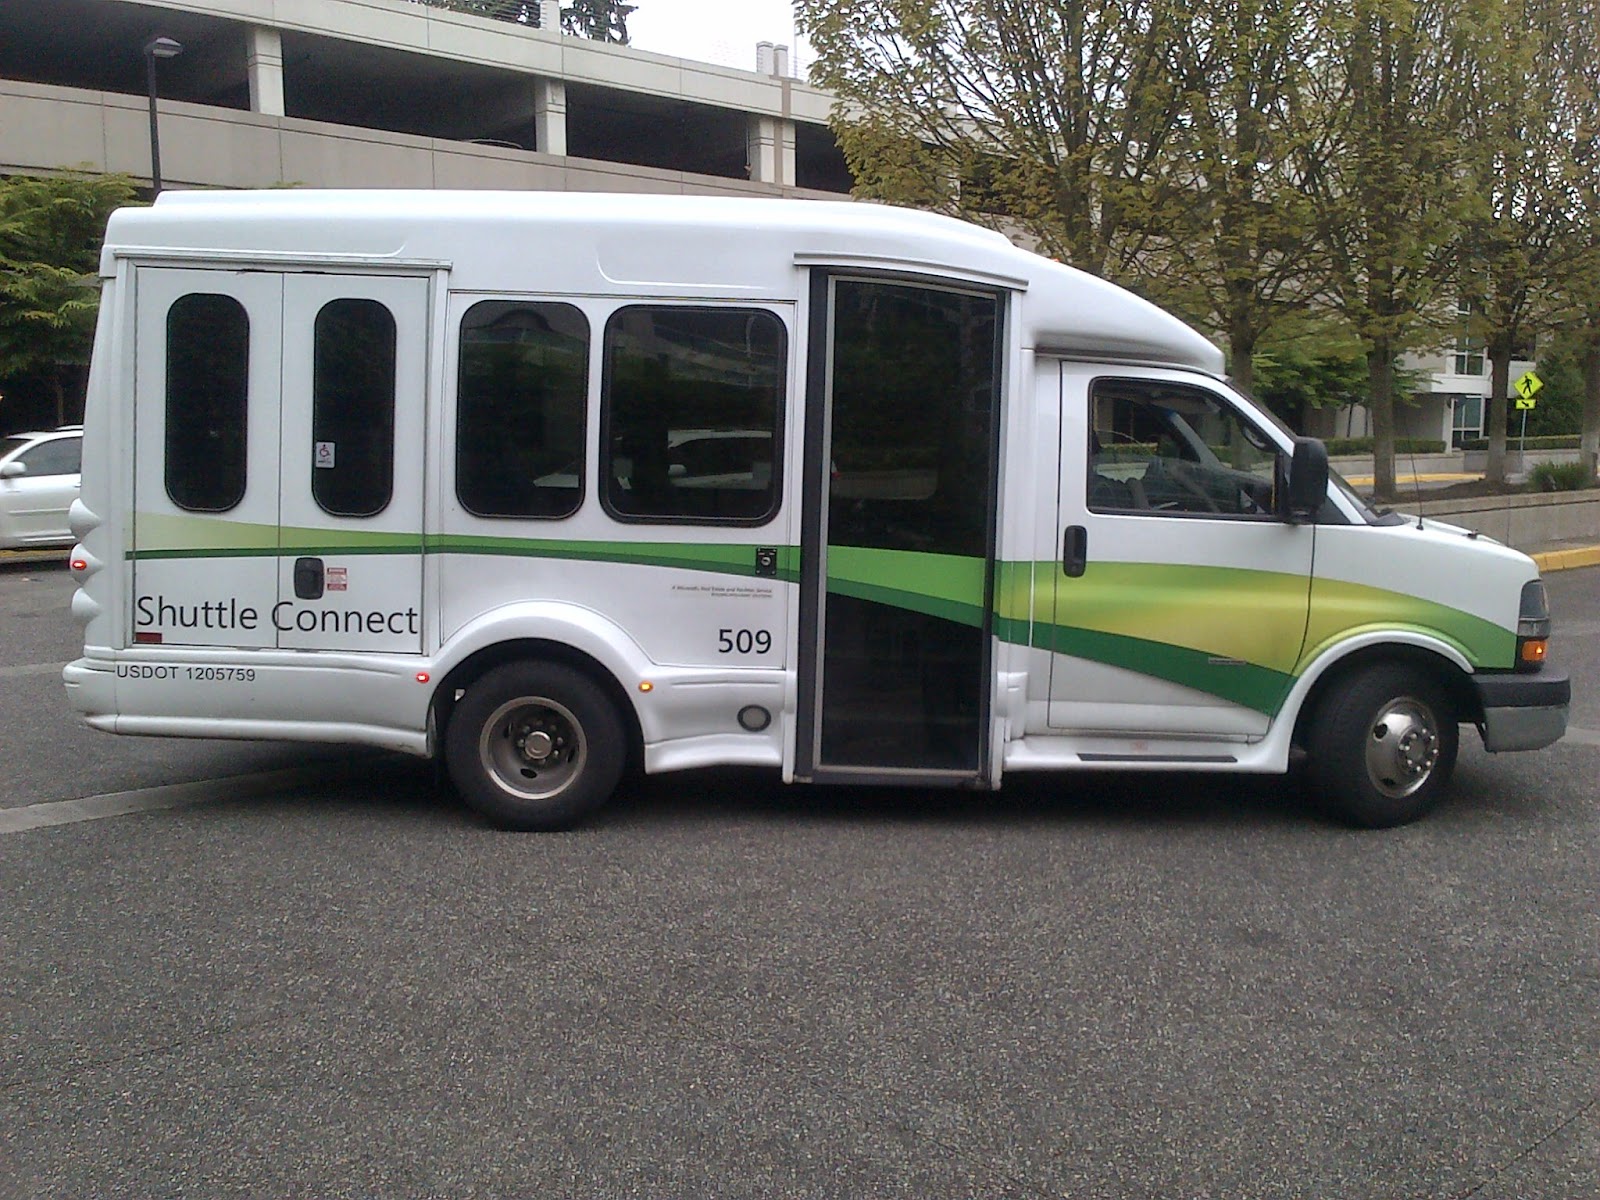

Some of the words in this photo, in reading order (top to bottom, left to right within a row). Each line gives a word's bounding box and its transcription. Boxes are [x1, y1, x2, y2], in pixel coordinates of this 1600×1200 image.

[136, 596, 258, 629] Shuttle
[271, 600, 419, 634] Connect
[718, 628, 772, 654] 509
[116, 665, 179, 679] USDOT
[185, 667, 256, 681] 1205759
